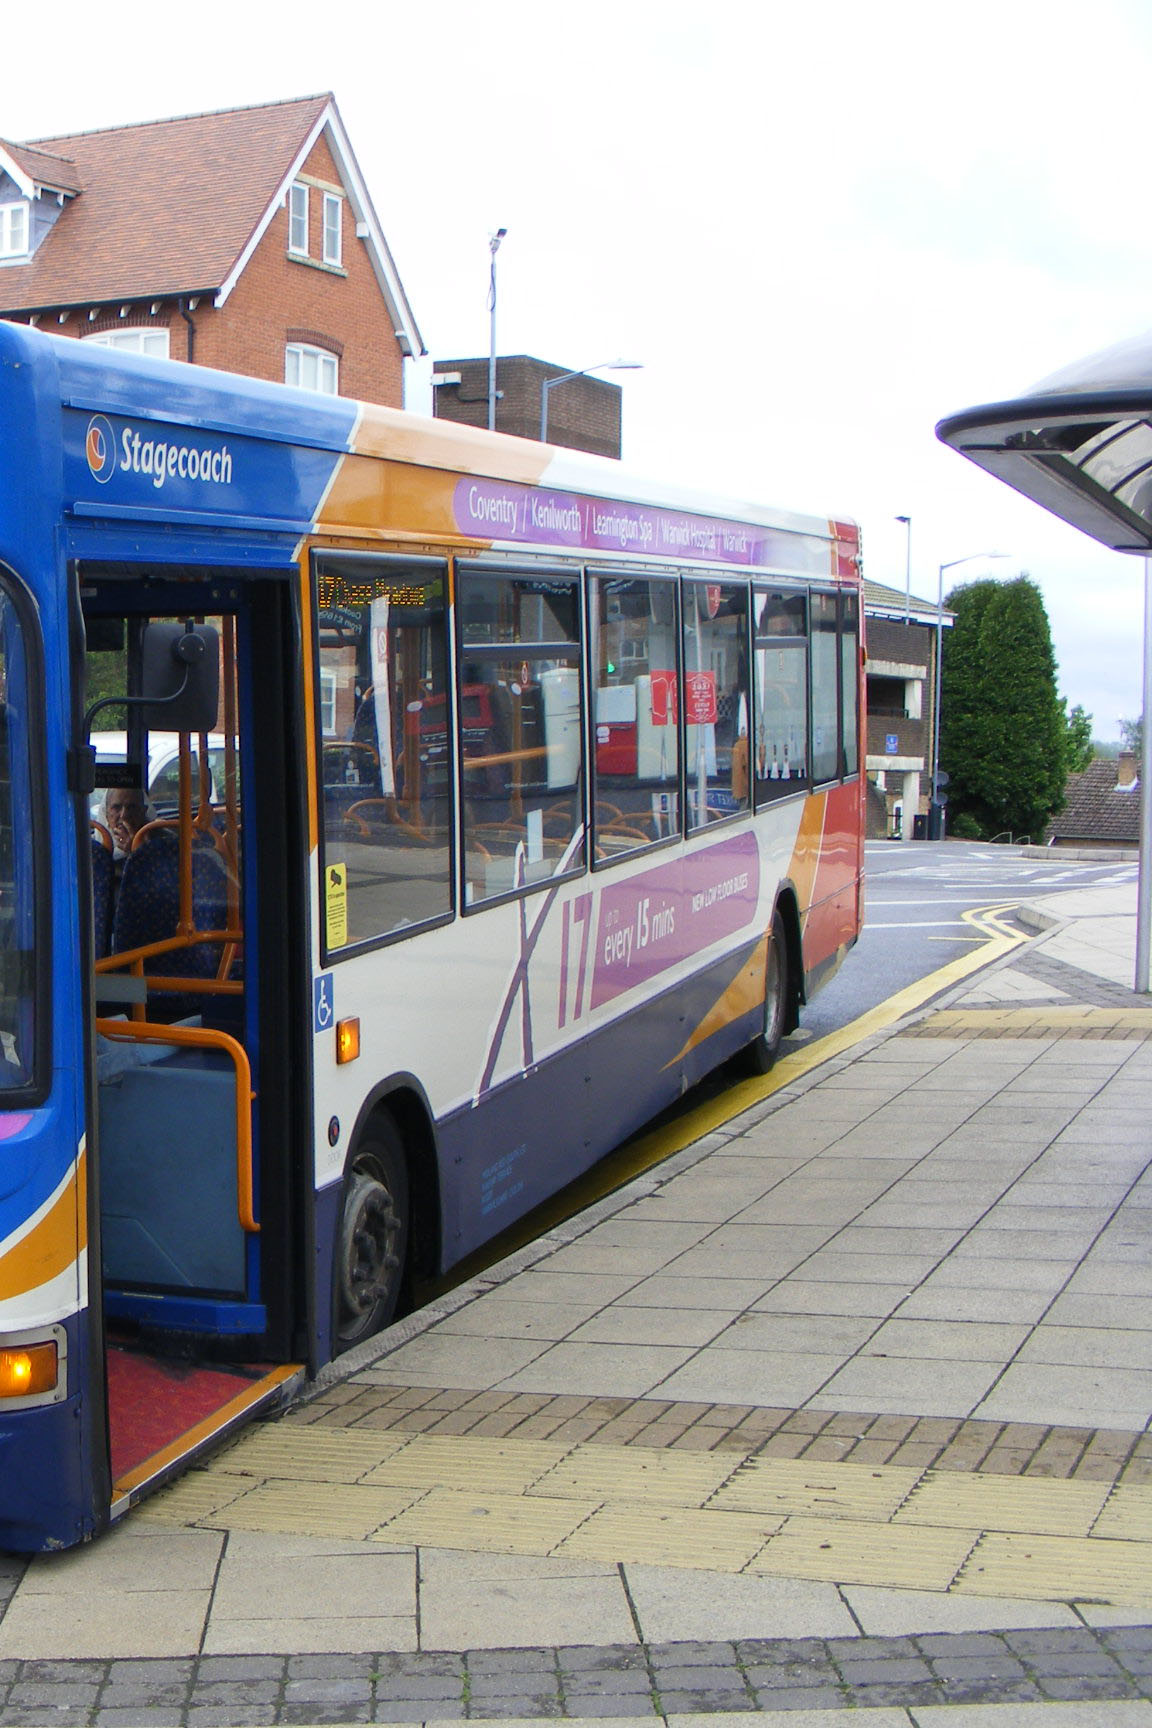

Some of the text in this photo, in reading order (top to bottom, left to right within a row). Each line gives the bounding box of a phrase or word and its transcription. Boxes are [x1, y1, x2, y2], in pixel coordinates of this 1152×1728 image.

[120, 427, 232, 488] Stagecoach
[469, 486, 518, 534] Coventry
[531, 497, 582, 533] Kenilworth
[592, 506, 638, 547] Leamington
[639, 515, 653, 549] Spa
[661, 518, 692, 548] Warwick
[691, 524, 716, 556] Hospital
[723, 528, 748, 554] Warwick
[472, 822, 594, 1109] X17
[604, 897, 675, 968] every 15 mins
